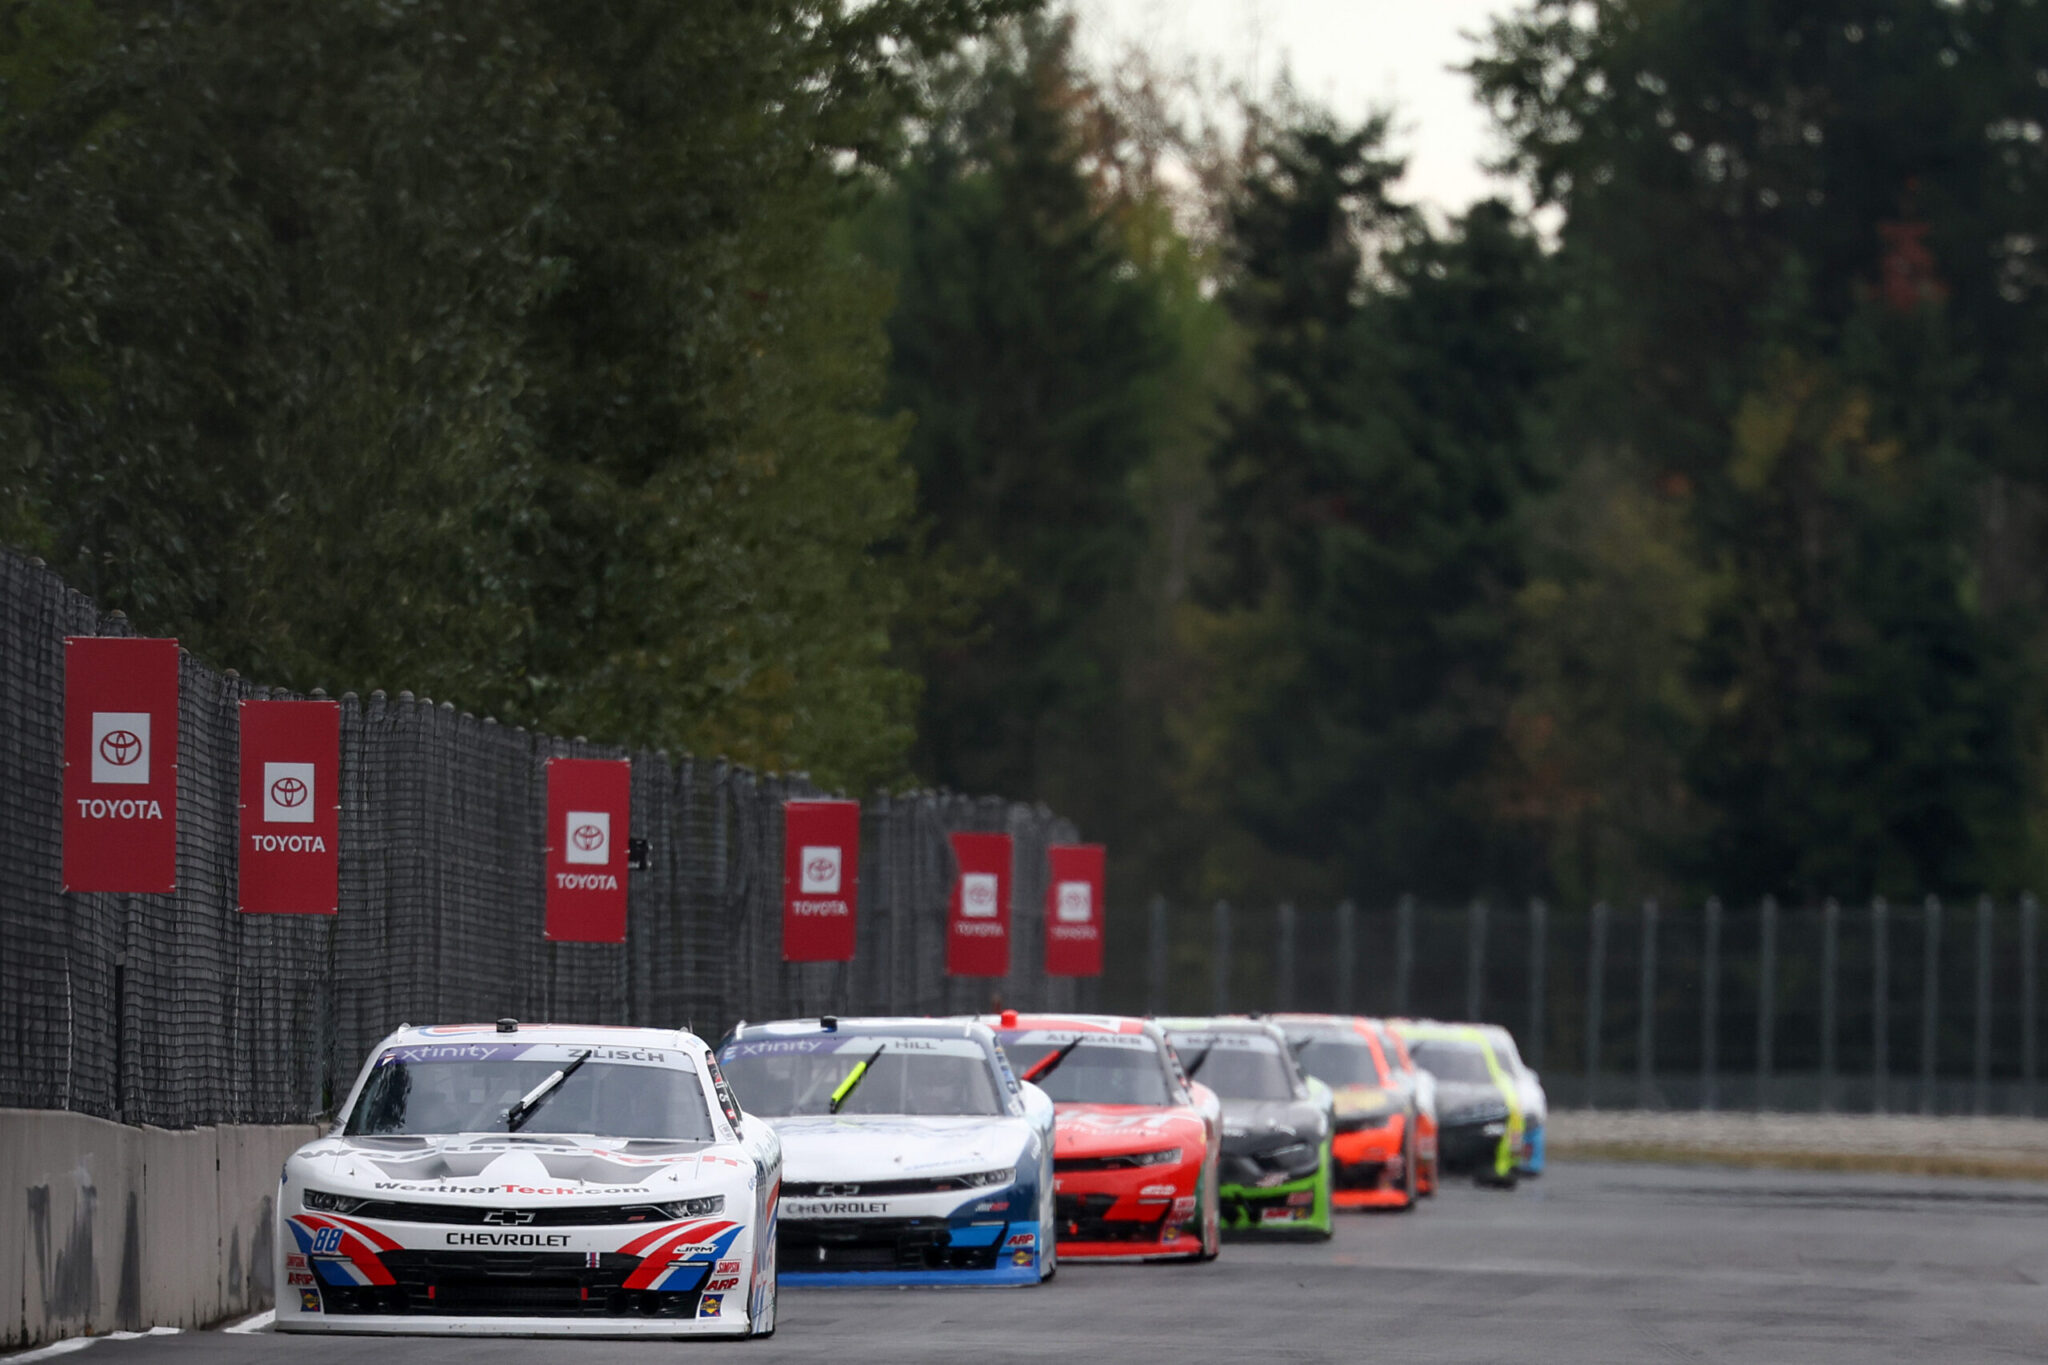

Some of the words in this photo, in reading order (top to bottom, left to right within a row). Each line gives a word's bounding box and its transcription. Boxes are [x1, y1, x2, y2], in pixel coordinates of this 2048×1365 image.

[77, 799, 163, 820] TOYOTA
[251, 834, 326, 853] TOYOTA
[556, 873, 618, 890] TOYOTA
[792, 900, 848, 916] TOYOTA
[741, 1039, 822, 1056] xfinity
[895, 1040, 937, 1050] HILL
[401, 1045, 499, 1062] xfinity
[567, 1048, 665, 1063] ZLISCH
[374, 1180, 650, 1196] WeatherTech.com
[785, 1202, 889, 1214] CHEVROLET
[312, 1227, 345, 1252] 88
[446, 1232, 572, 1247] CHEVROLET
[1006, 1233, 1035, 1246] ARP
[676, 1245, 713, 1253] JRM
[716, 1261, 741, 1275] SIMPSON
[705, 1277, 740, 1291] ARP
